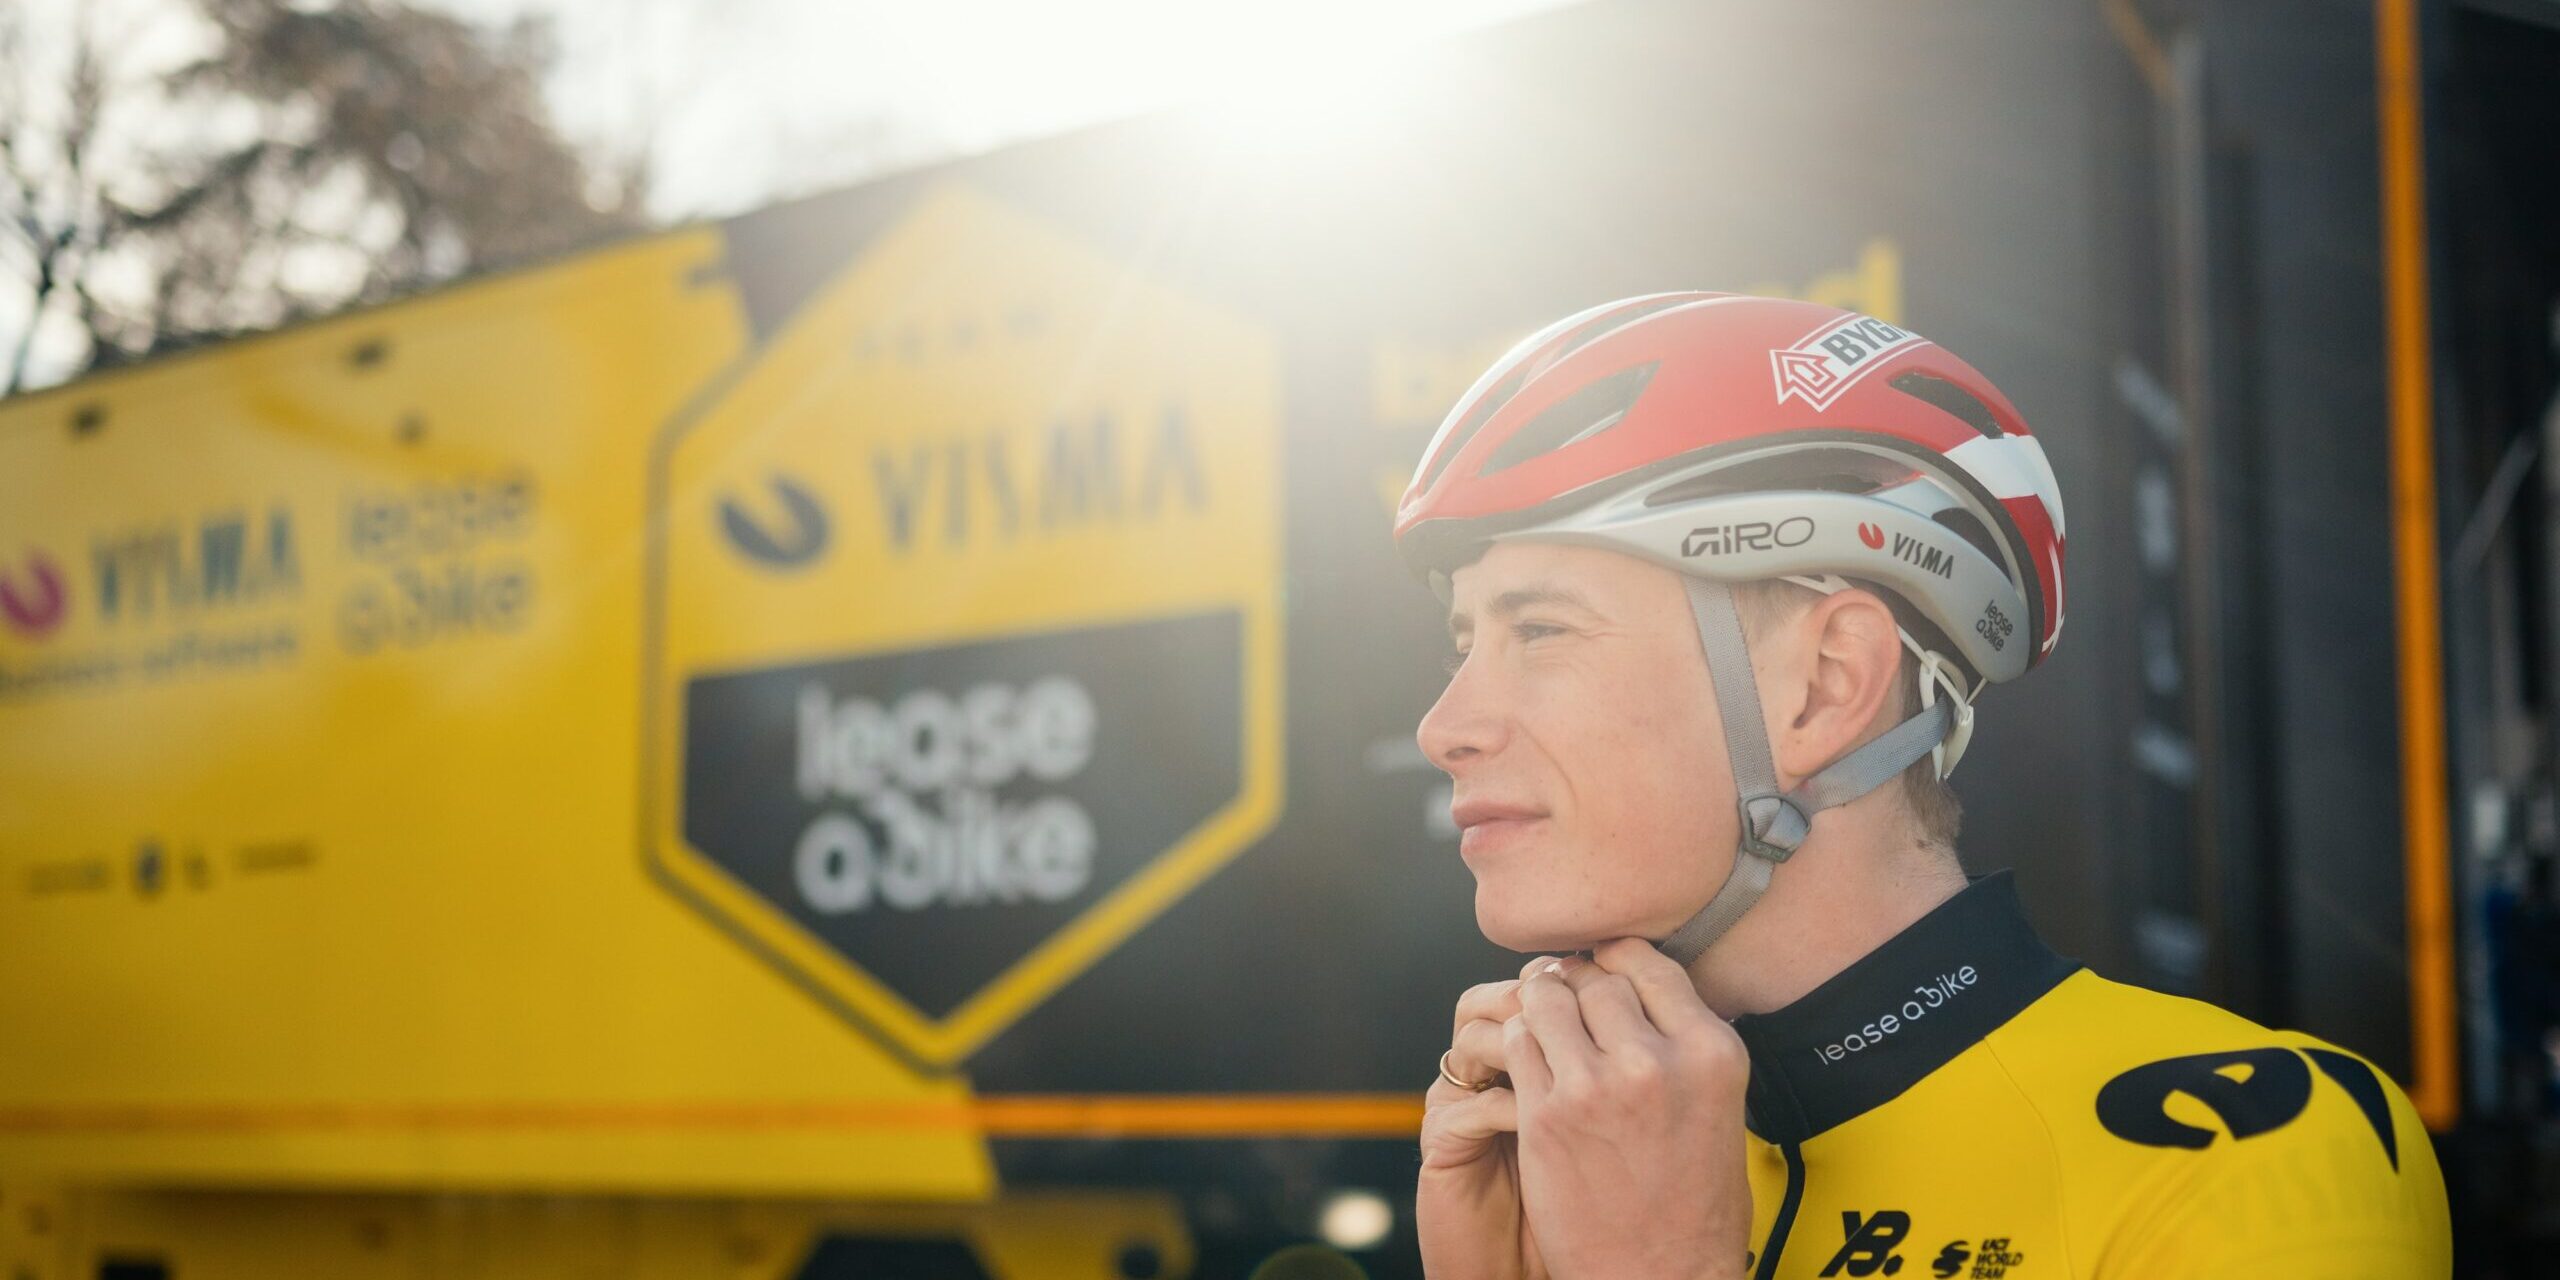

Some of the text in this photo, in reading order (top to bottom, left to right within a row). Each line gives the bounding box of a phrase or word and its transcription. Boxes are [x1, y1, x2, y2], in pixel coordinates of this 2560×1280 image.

[1820, 318, 1908, 366] BYG
[1681, 516, 1815, 557] GIRO
[1893, 532, 1954, 579] VISMA
[1984, 599, 2013, 636] lease
[797, 680, 1093, 798] lease
[1813, 1014, 1900, 1066] lease
[1970, 1267, 2006, 1279] TEAM
[1976, 1252, 2024, 1267] WORLD
